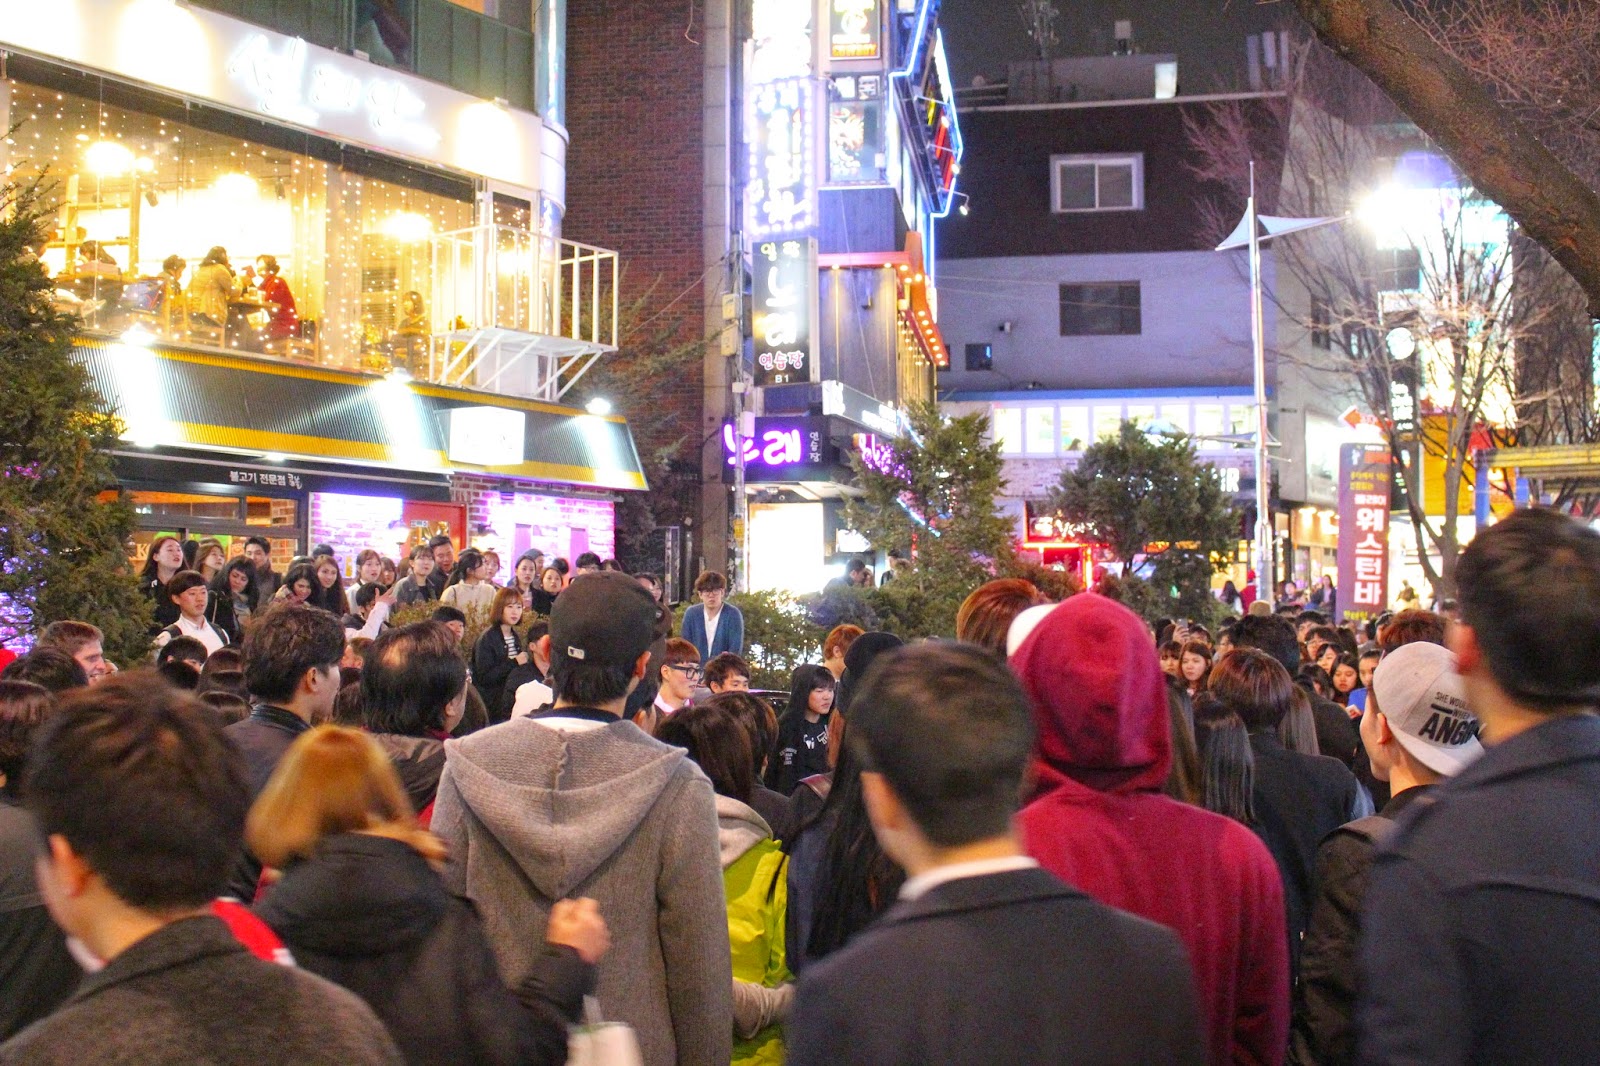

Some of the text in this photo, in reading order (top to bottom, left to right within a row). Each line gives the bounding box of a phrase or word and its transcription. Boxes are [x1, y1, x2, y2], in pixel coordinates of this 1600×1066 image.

[759, 350, 805, 371] 연습장
[724, 424, 801, 465] 노래
[229, 470, 258, 484] 불고기
[259, 473, 286, 486] 전문점
[1353, 508, 1385, 606] 웨스턴바
[1435, 691, 1449, 703] SHE
